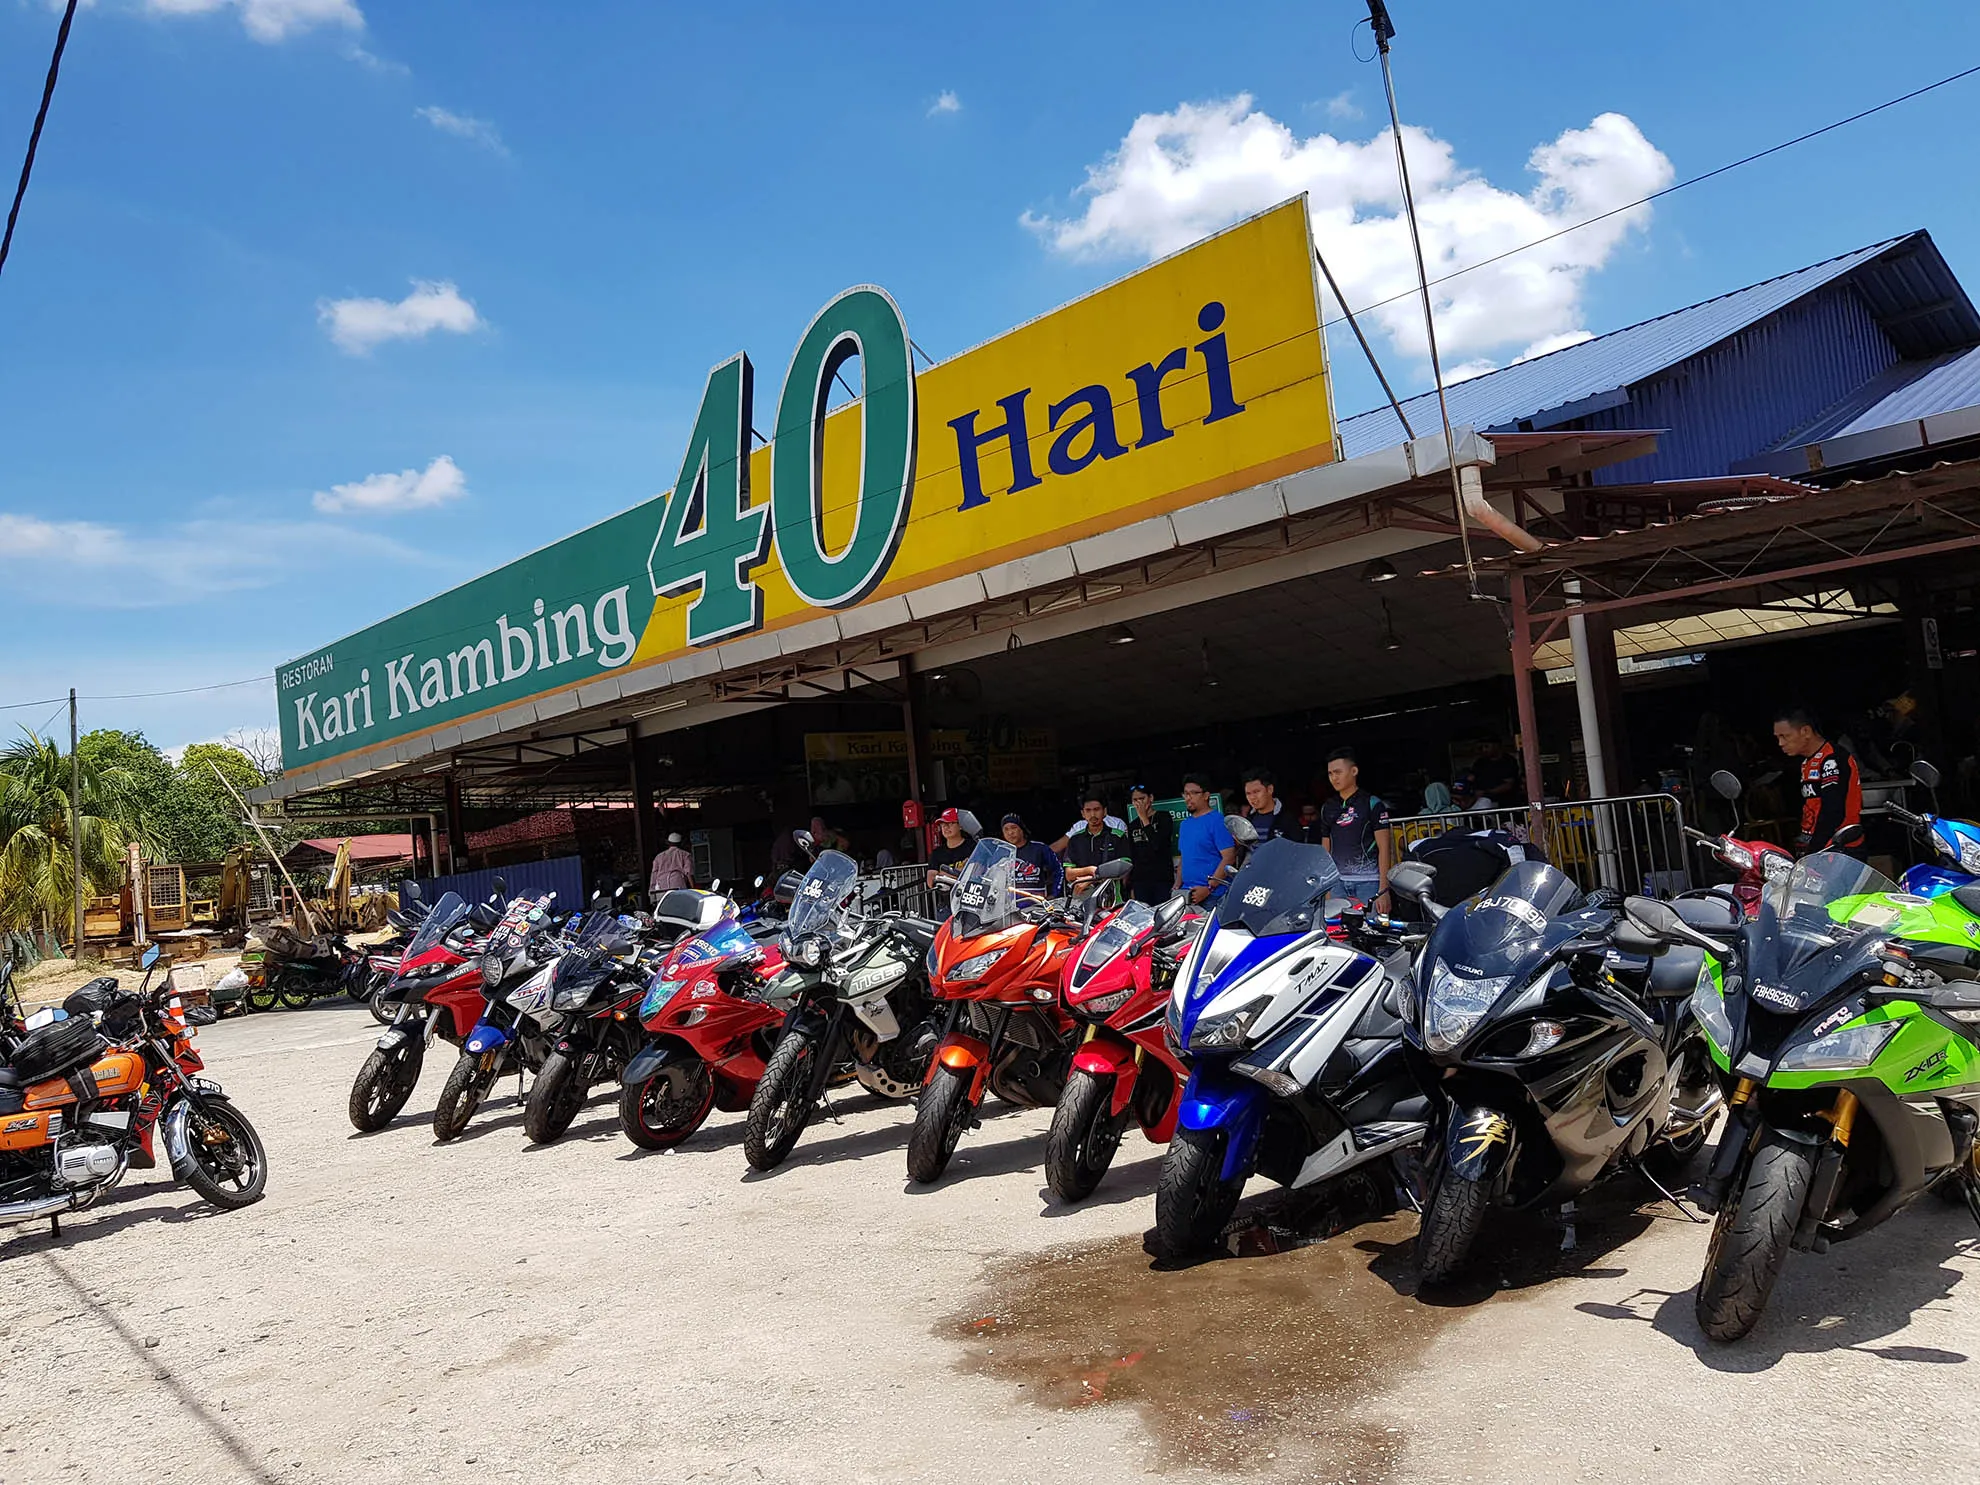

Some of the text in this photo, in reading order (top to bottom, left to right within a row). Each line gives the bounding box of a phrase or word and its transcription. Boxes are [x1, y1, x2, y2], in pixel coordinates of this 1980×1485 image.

[294, 283, 1246, 751] Kari Kambing 40 Hari
[282, 653, 334, 690] RESTORAN
[446, 967, 470, 980] DUCATI
[851, 962, 908, 992] TIGER
[1454, 963, 1484, 977] SUZUKI
[1753, 984, 1798, 1008] FBH9626U
